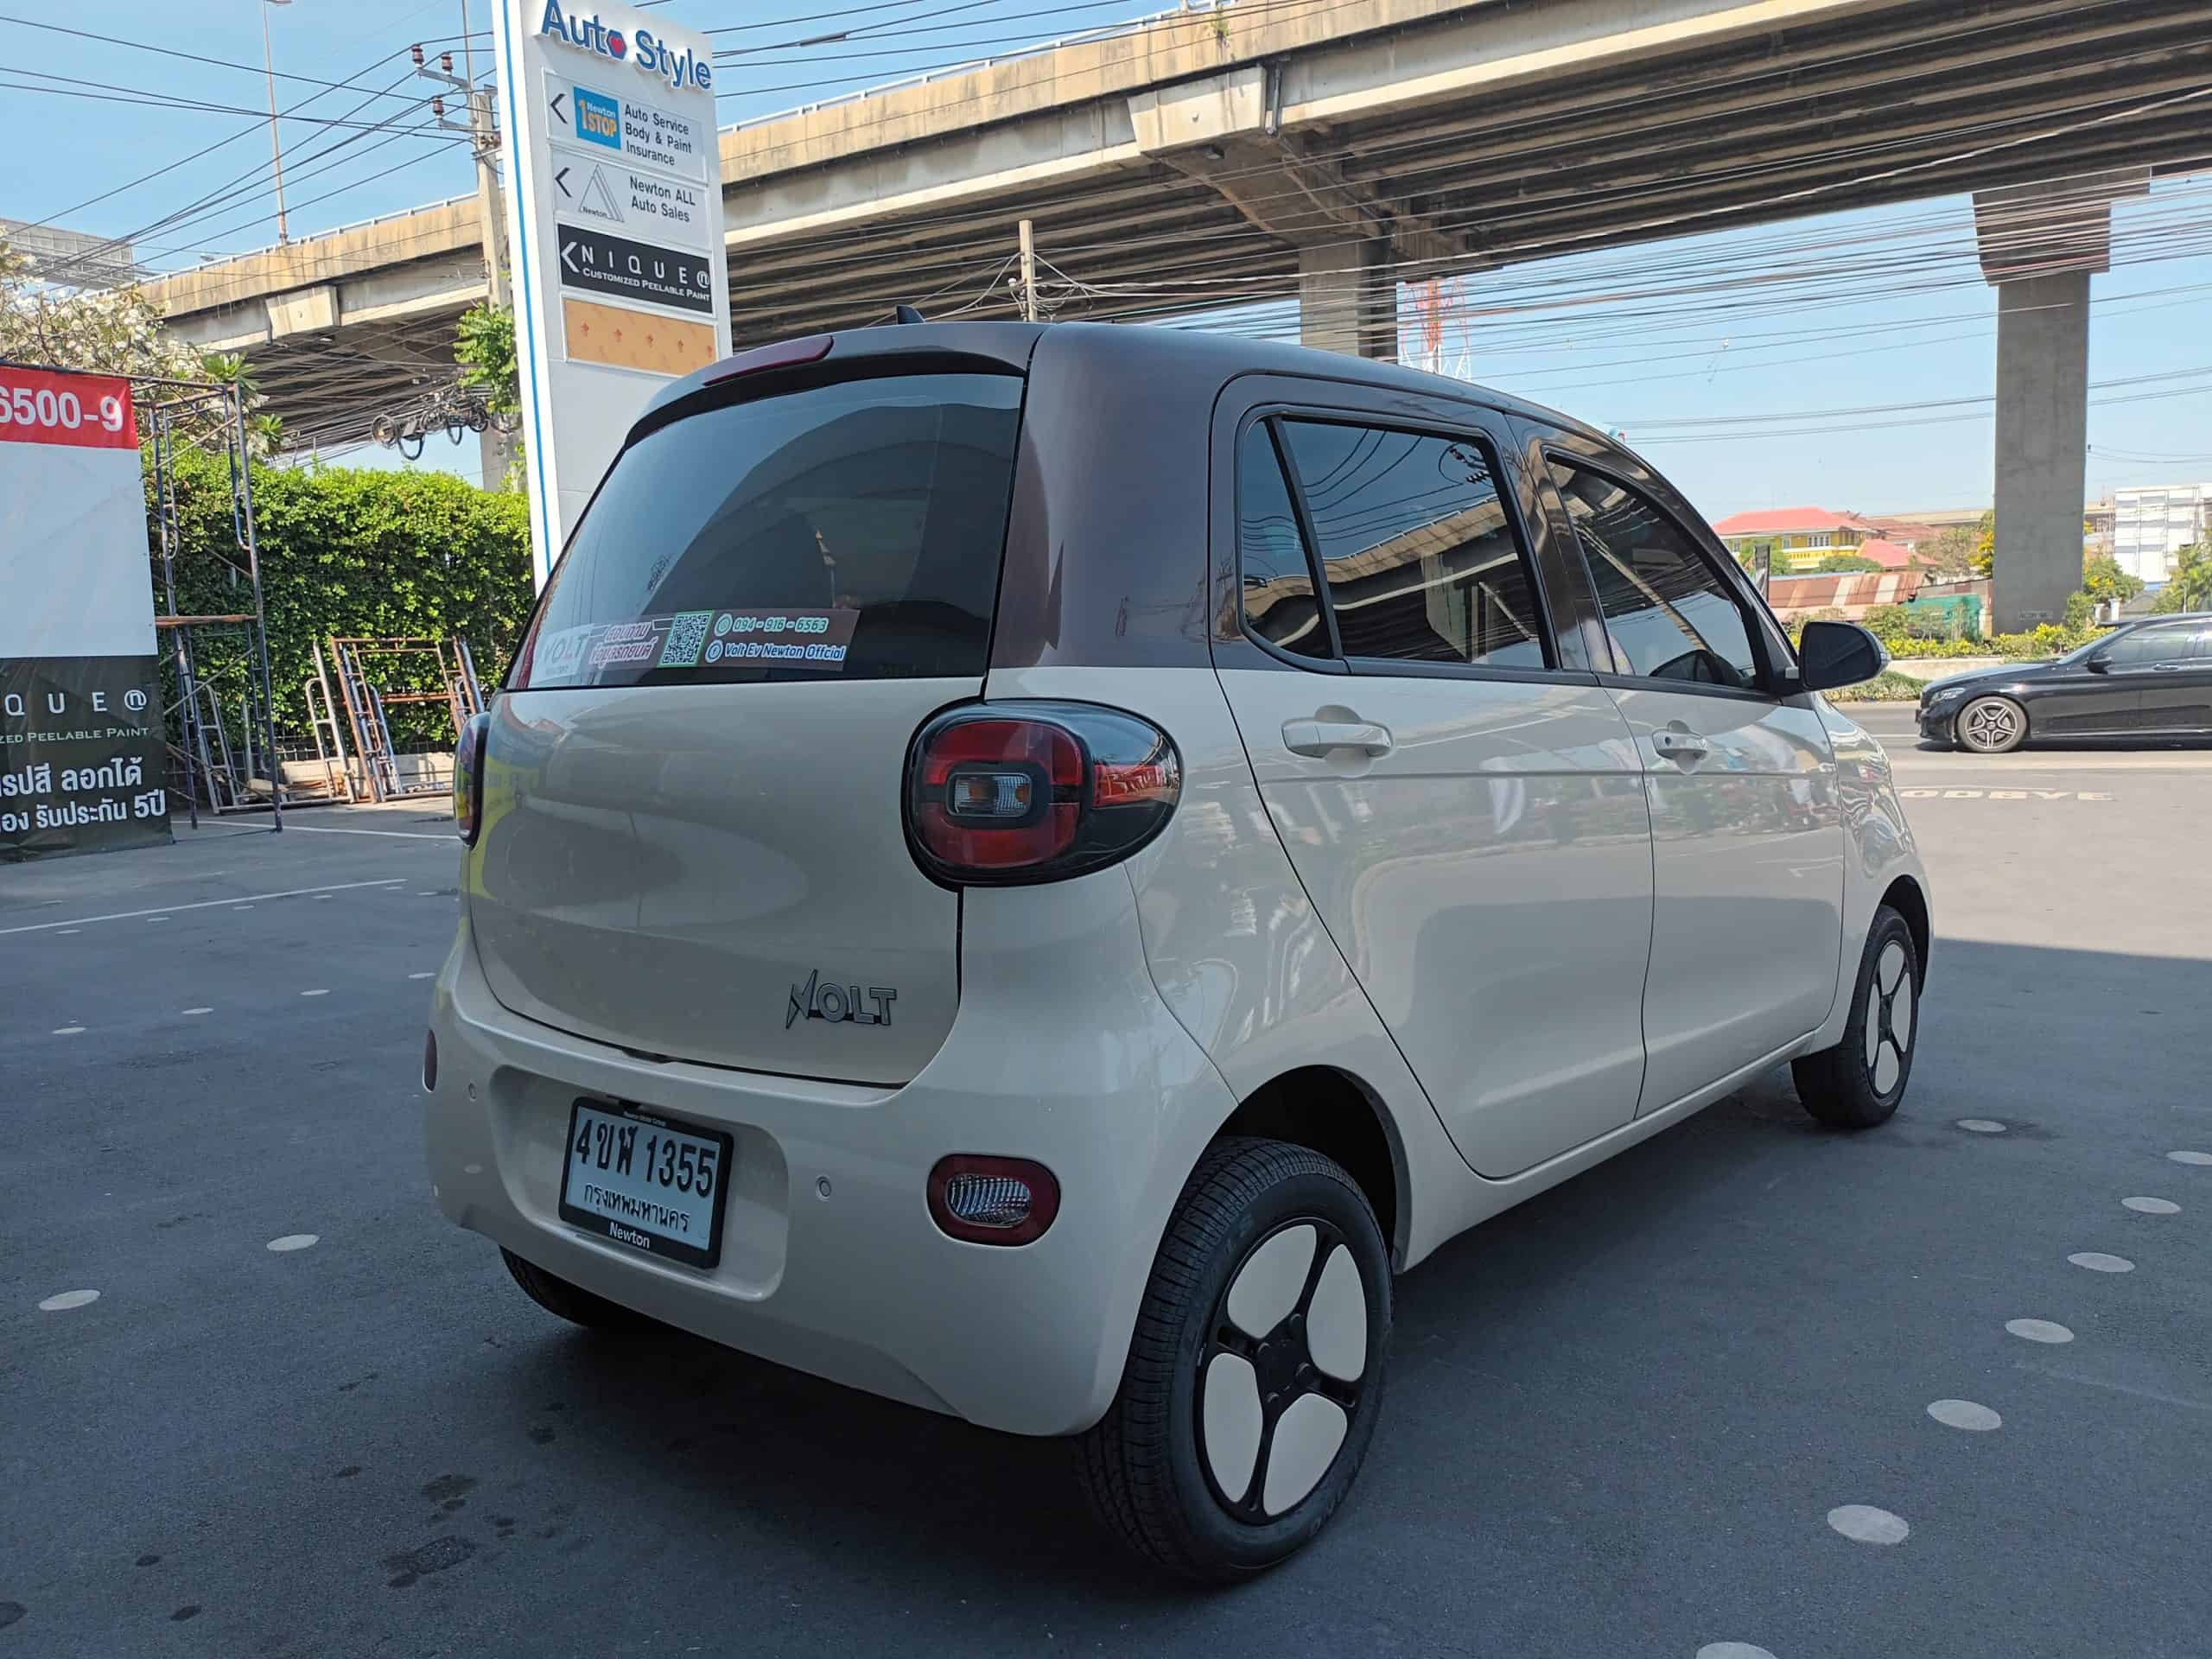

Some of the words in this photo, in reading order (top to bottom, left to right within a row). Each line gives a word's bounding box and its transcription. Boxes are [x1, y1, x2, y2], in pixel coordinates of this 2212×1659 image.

[634, 29, 712, 90] Style
[587, 101, 616, 118] Newton
[624, 103, 649, 123] Auto
[652, 112, 690, 136] Service
[625, 122, 651, 143] Body
[655, 131, 663, 145] &
[667, 135, 692, 155] Paint
[626, 139, 676, 166] Insurance
[629, 175, 671, 200] Newton
[676, 188, 696, 207] ALL
[631, 194, 657, 214] Auto
[660, 202, 691, 223] Sales
[725, 643, 747, 657] Volt
[762, 644, 804, 658] Newton
[0, 762, 52, 797] รปสี
[61, 757, 143, 791] ลอกได้
[36, 798, 127, 828] รับประกัน
[646, 1135, 716, 1198] 1355
[584, 1184, 690, 1232] กรุงเทพมหานคร
[608, 1221, 651, 1249] Newton
